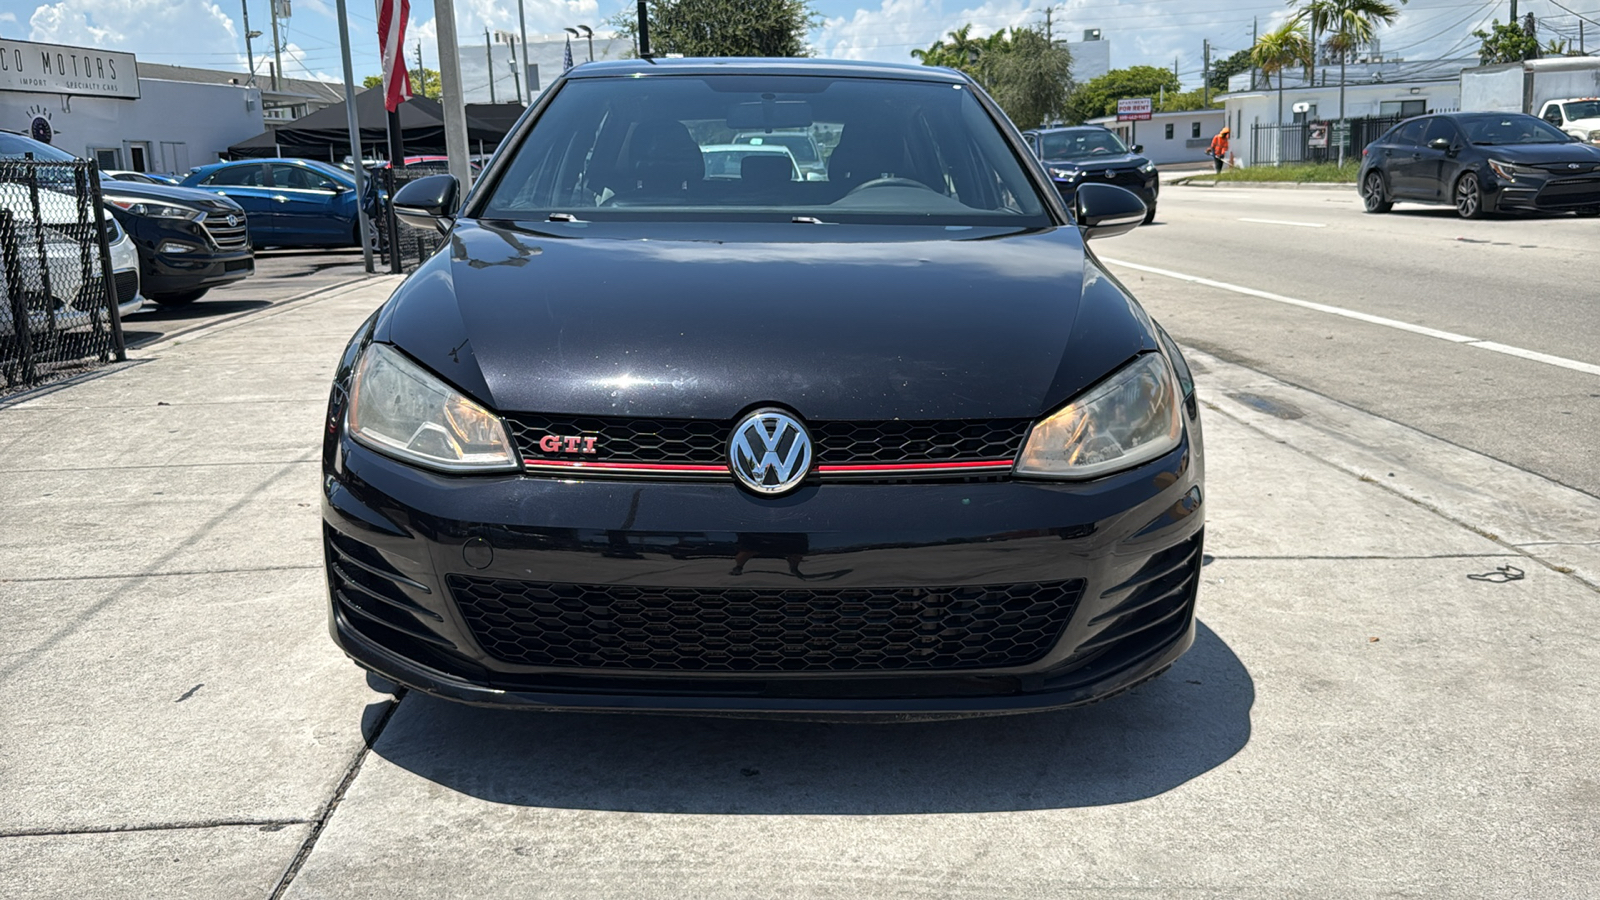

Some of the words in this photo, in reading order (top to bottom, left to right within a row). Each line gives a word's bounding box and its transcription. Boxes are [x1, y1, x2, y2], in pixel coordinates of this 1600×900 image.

[41, 51, 117, 80] MOTORS
[19, 78, 47, 87] IMPORT
[66, 81, 100, 90] SPECIALTY
[102, 84, 118, 92] CARS
[539, 434, 597, 453] GTI
